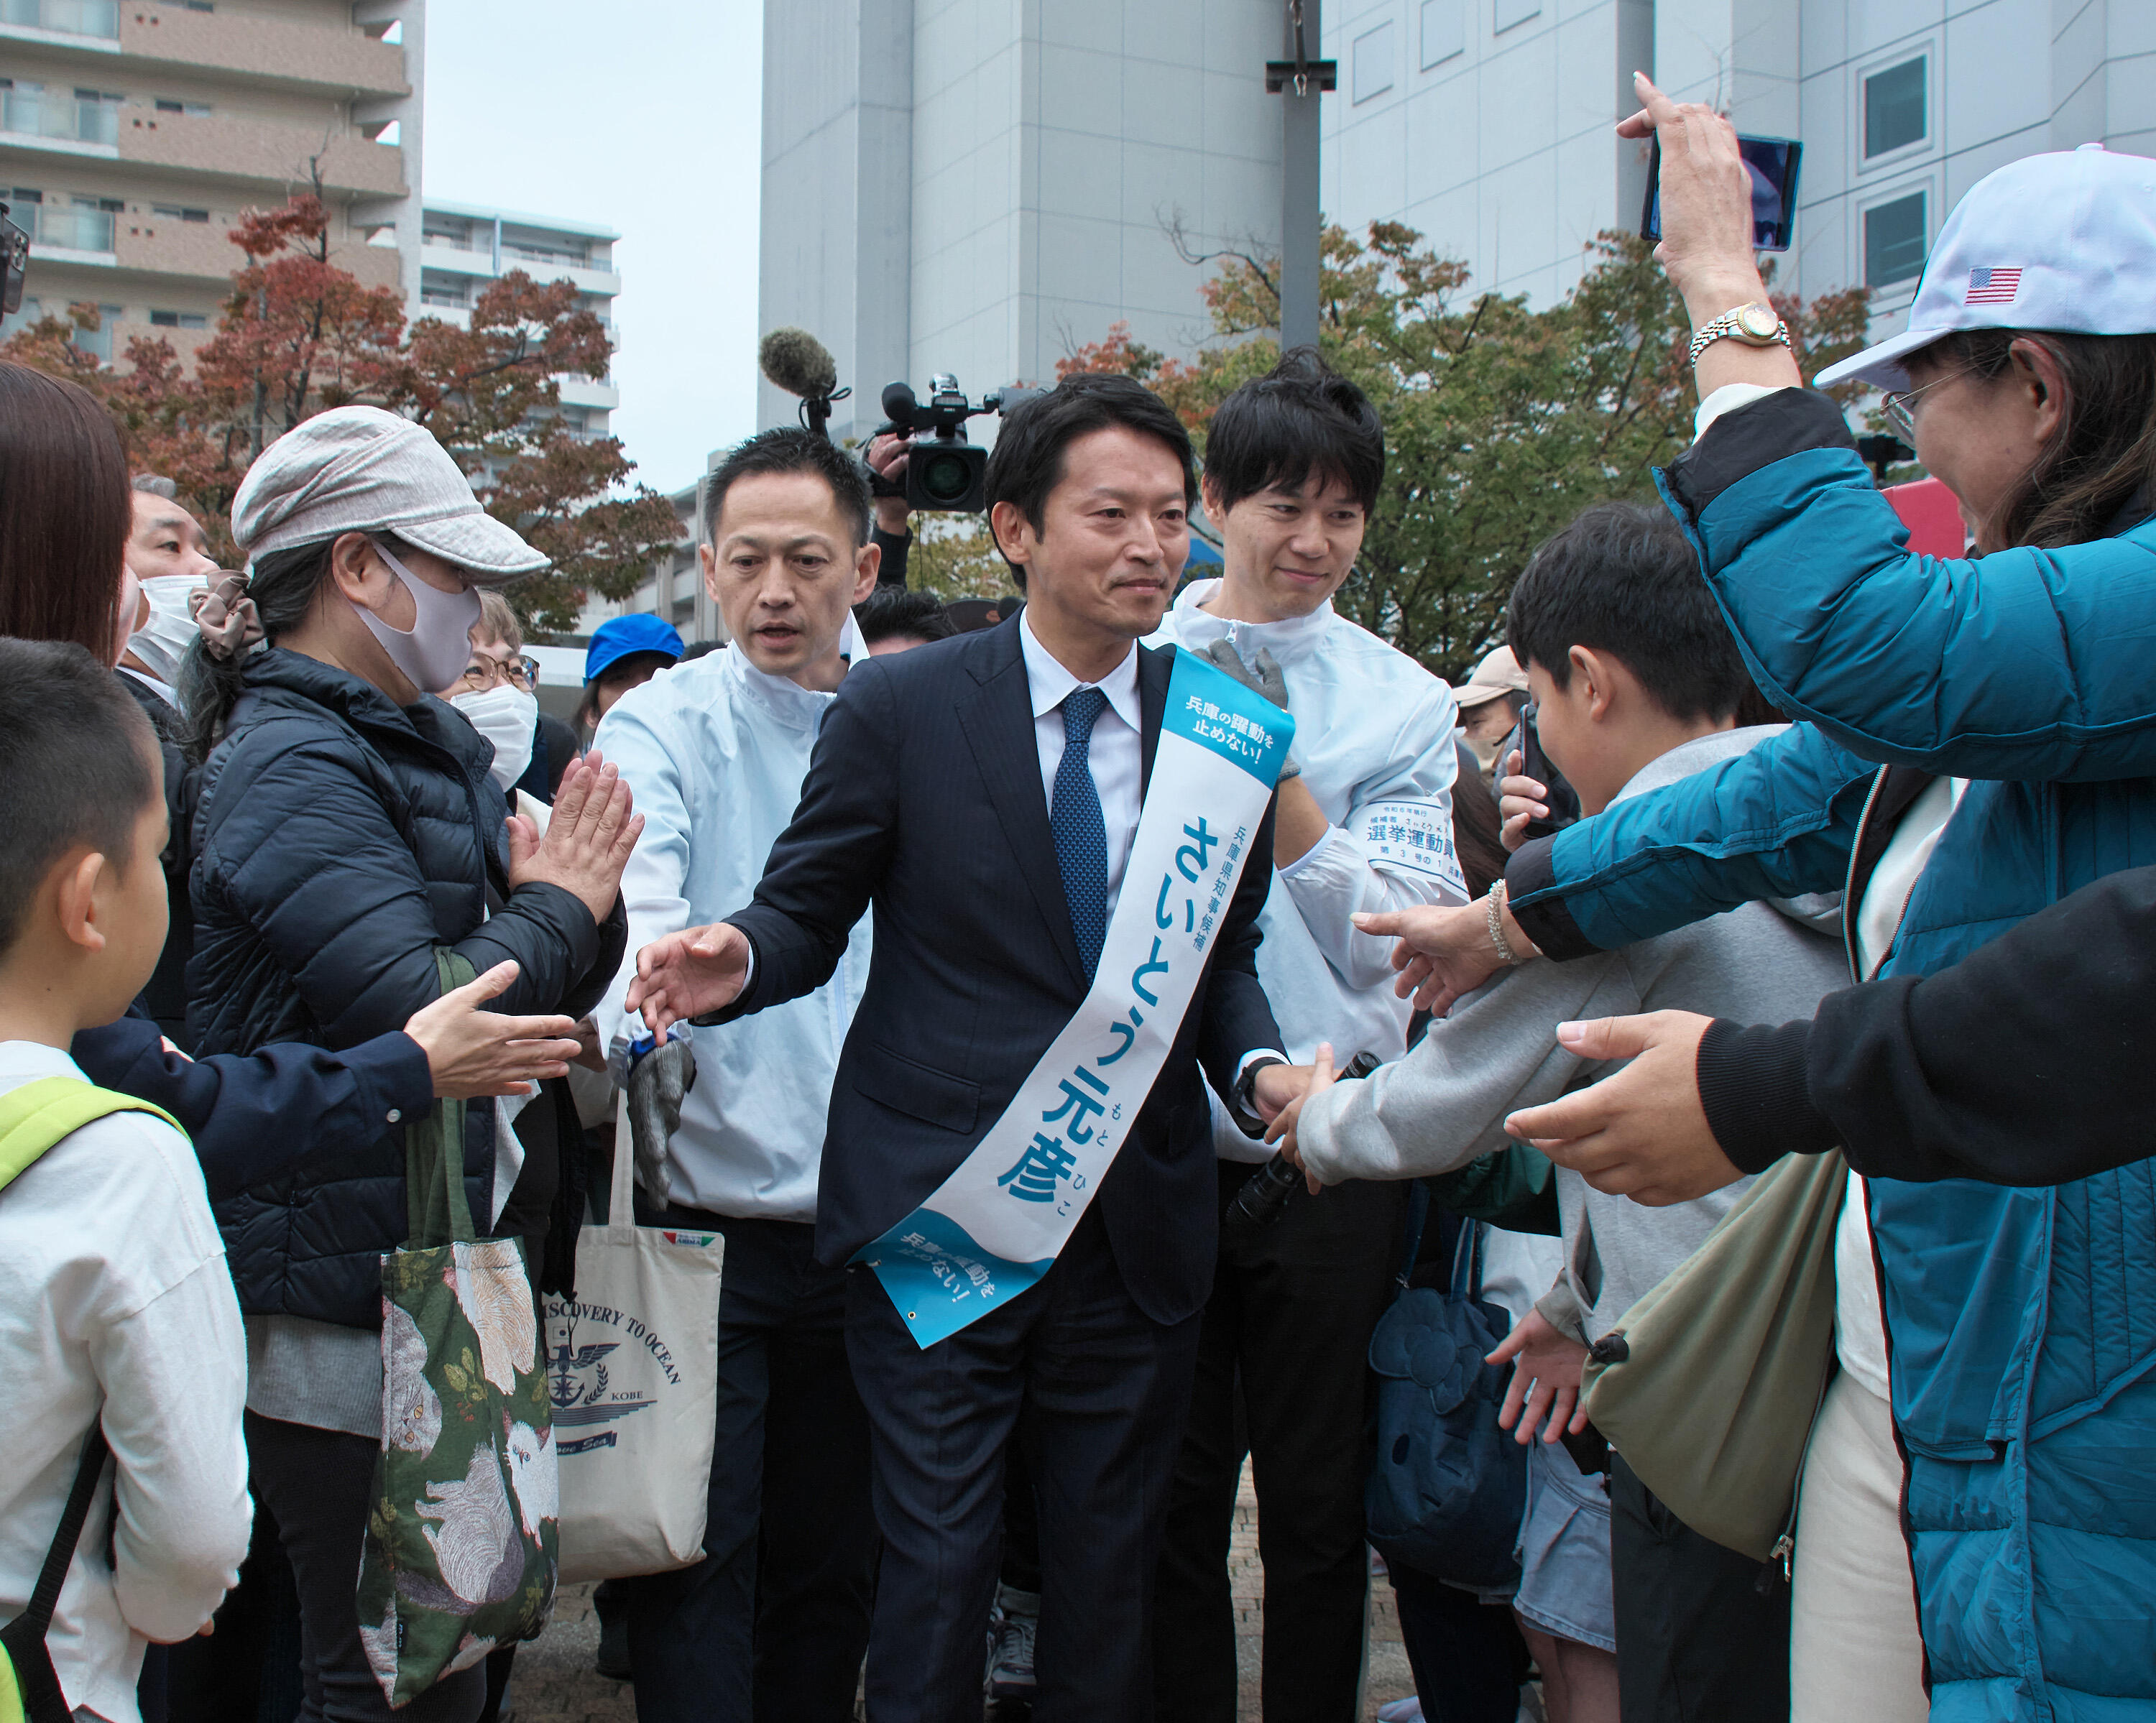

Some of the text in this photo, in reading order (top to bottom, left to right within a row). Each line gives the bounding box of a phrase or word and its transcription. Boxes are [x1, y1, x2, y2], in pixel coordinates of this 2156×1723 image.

[1185, 695, 1274, 749] 兵庫の躍動を
[1367, 824, 1453, 860] 選挙運動員
[1192, 826, 1247, 953] 兵庫県知事候補
[542, 1301, 681, 1385] ISCOVERY TO OCEAN
[612, 1390, 643, 1400] KOBE
[582, 1436, 607, 1449] Sea
